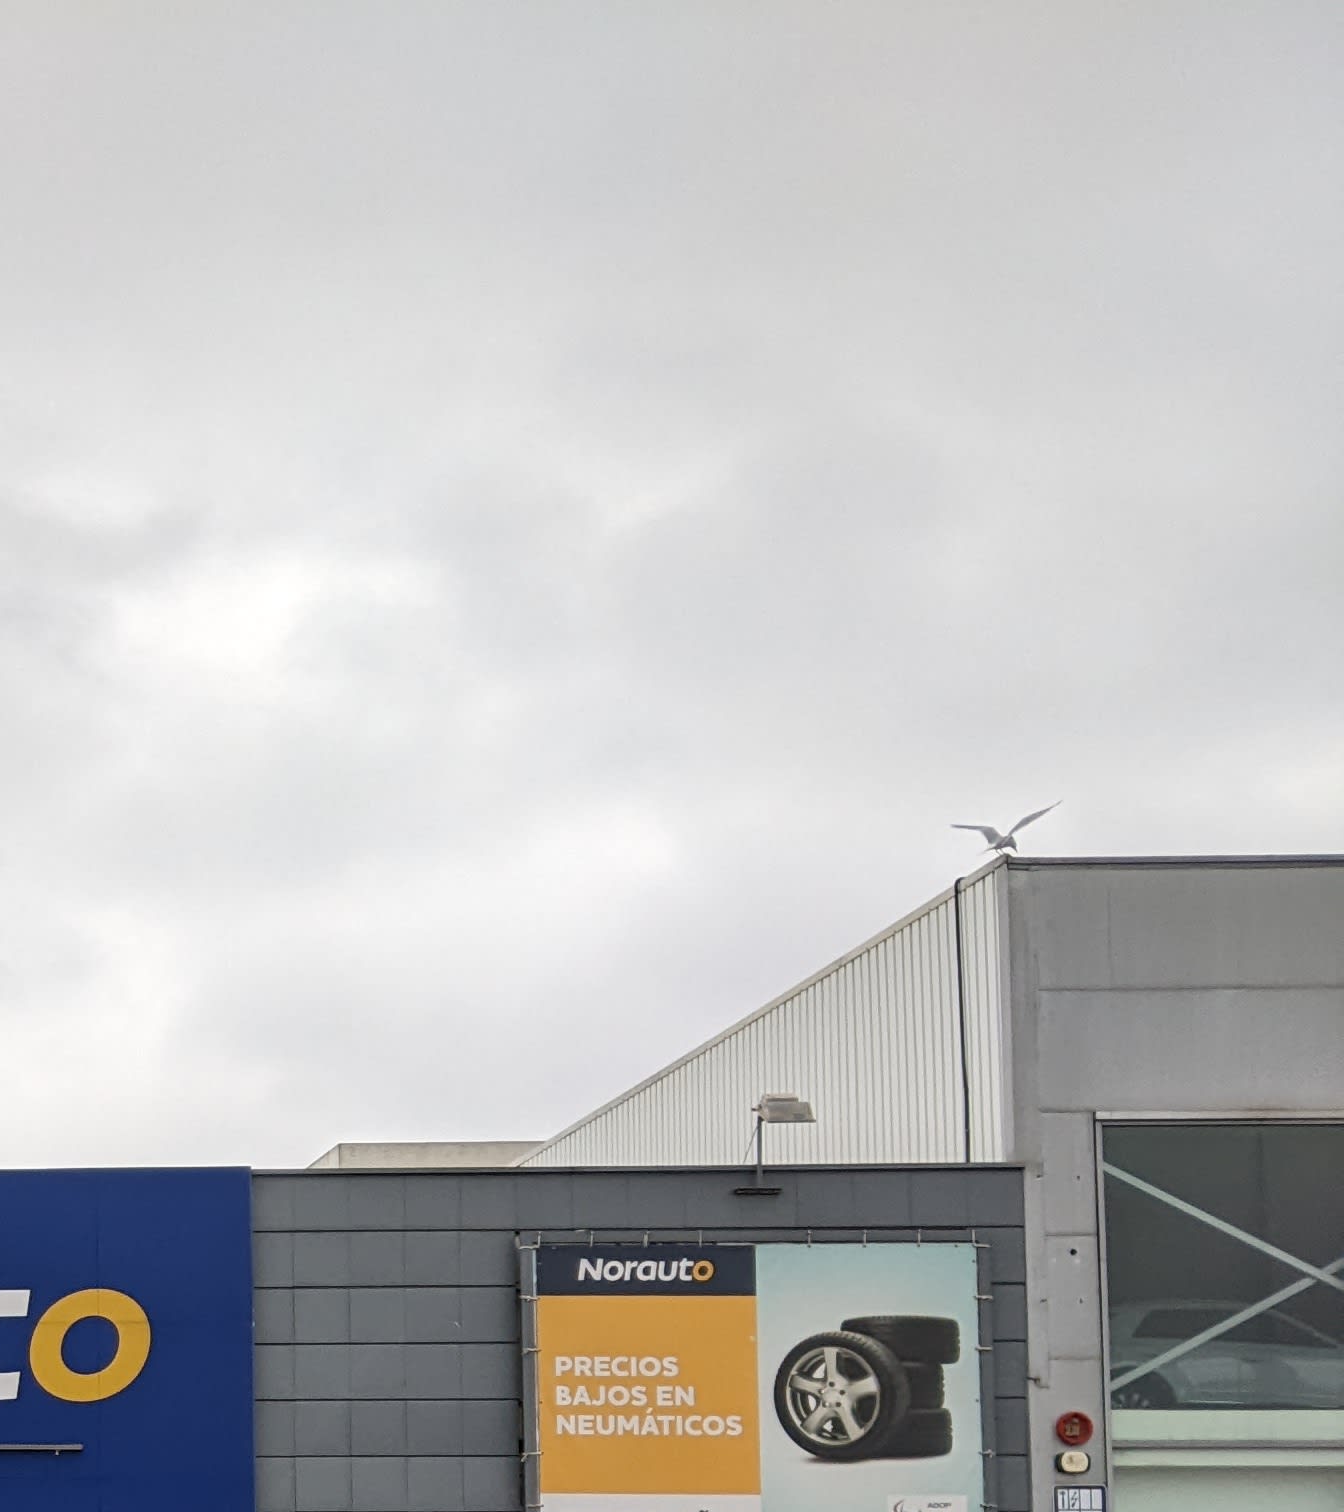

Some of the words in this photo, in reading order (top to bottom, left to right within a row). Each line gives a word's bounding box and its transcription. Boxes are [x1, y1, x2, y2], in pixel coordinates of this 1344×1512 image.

[578, 1258, 714, 1281] Norauto
[555, 1356, 679, 1377] PRECIOS
[556, 1386, 647, 1406] BAJOS
[656, 1386, 695, 1406] EN
[556, 1407, 743, 1436] NEUMÁTICOS
